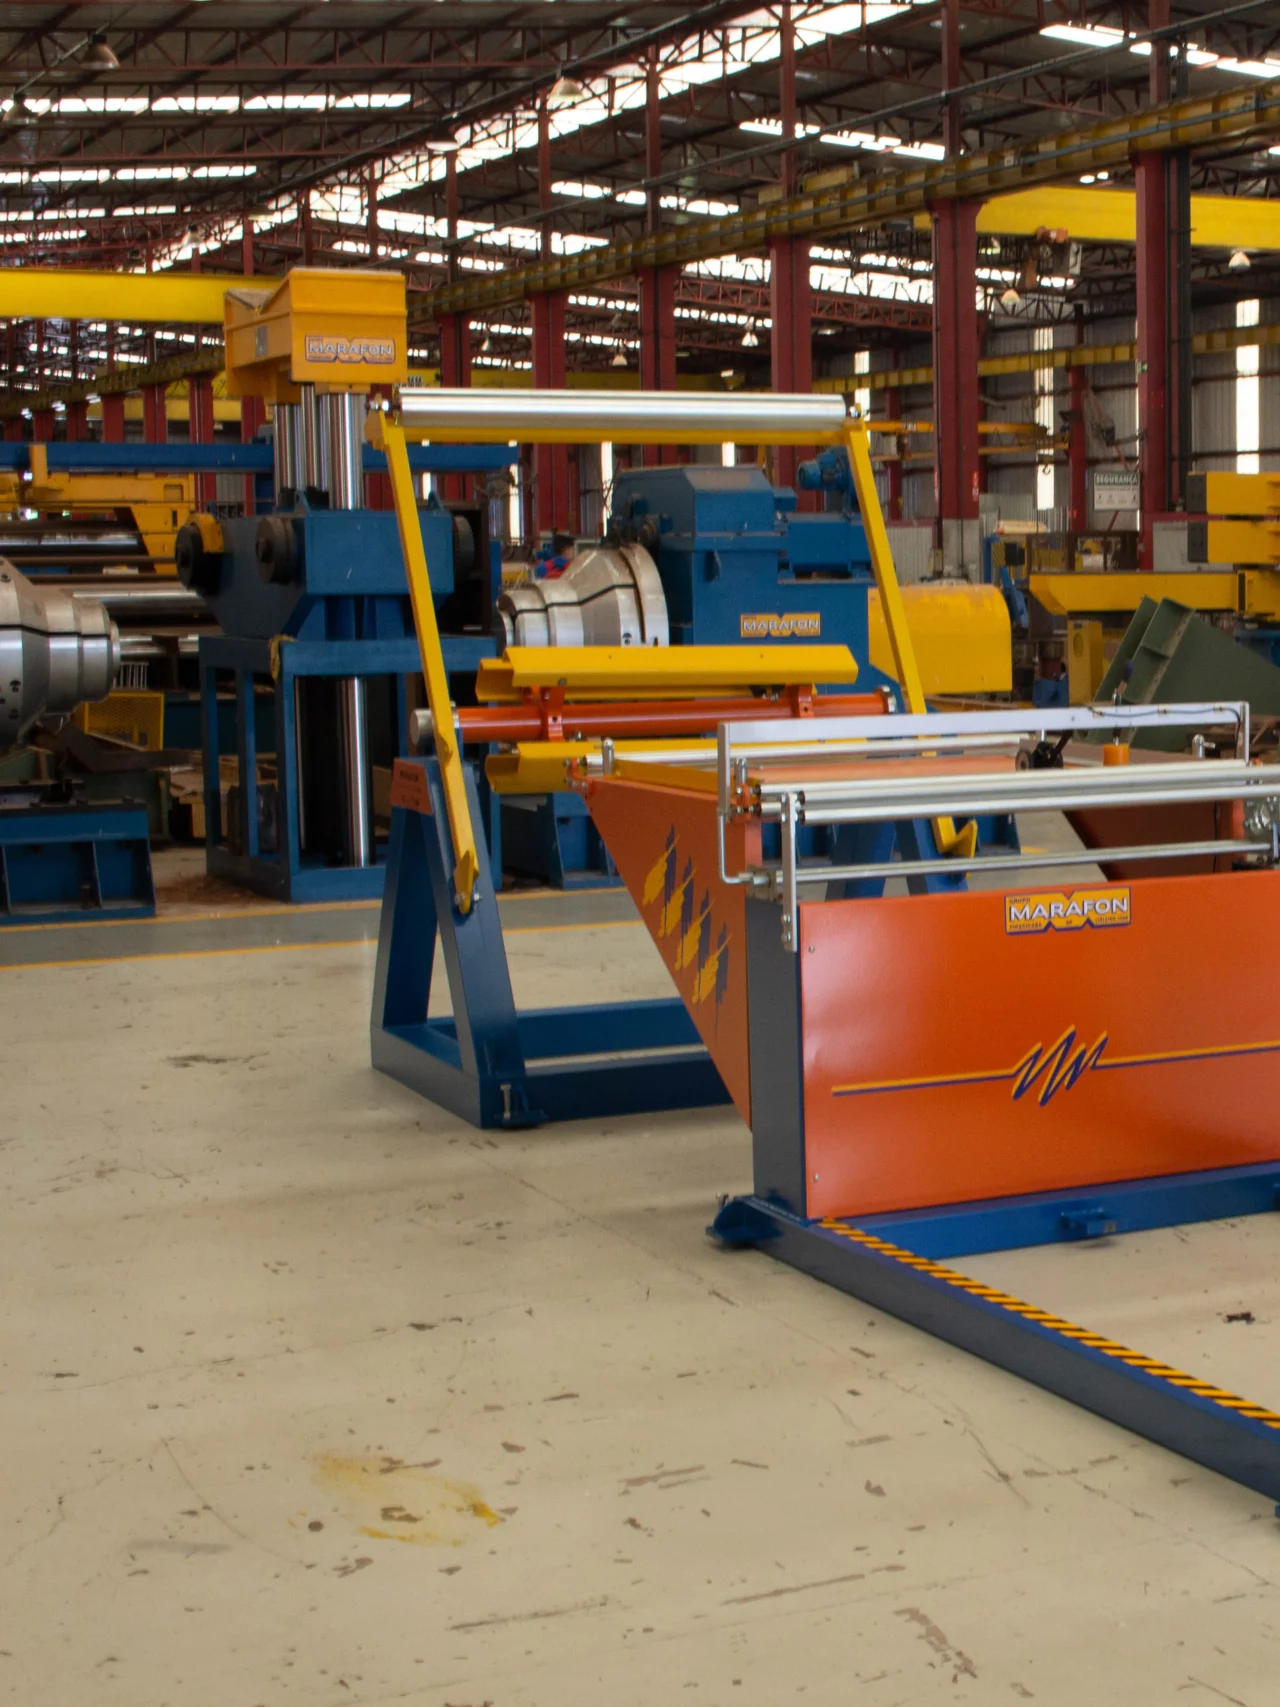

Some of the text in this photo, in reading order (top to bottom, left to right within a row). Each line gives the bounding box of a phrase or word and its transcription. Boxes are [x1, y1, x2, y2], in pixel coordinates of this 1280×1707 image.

[308, 341, 393, 355] MARAFON
[743, 618, 819, 630] MARAFON
[1009, 897, 1128, 921] MARAFON
